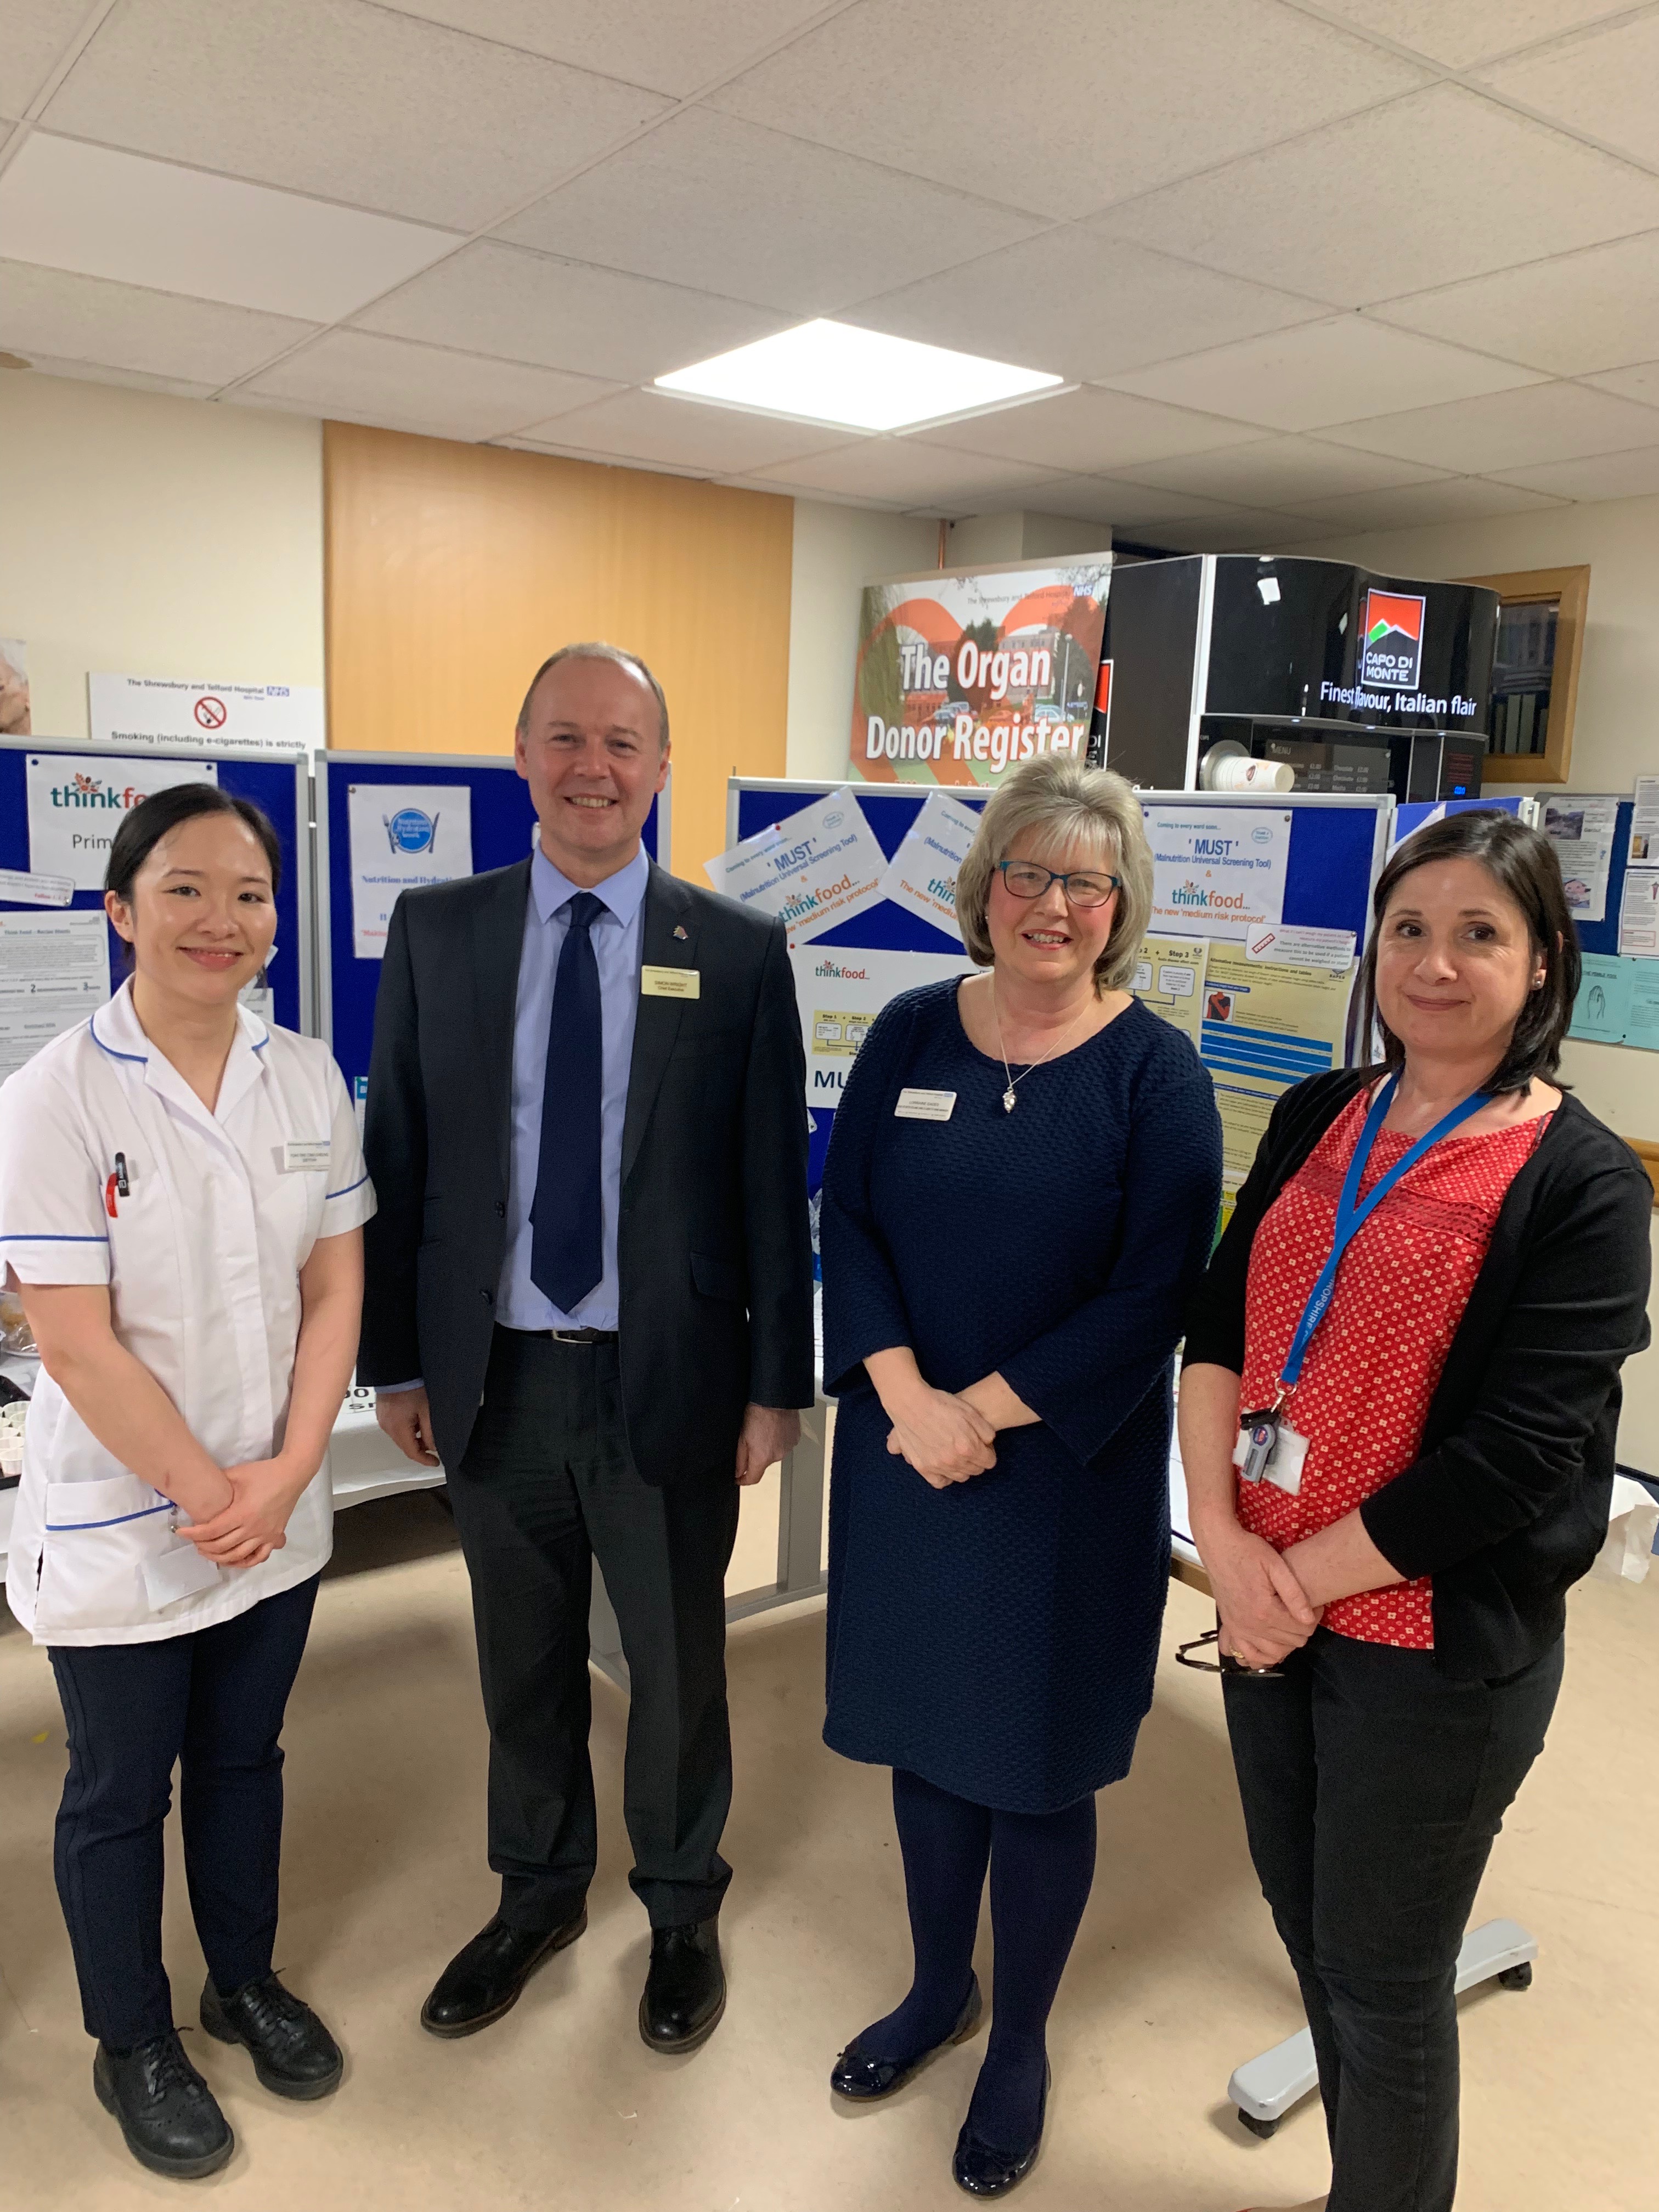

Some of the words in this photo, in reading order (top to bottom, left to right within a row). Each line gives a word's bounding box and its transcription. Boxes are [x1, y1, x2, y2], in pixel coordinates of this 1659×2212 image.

[1074, 585, 1093, 596] NHS
[1366, 651, 1396, 668] CAPO
[1398, 656, 1413, 669] DI
[901, 642, 950, 691] The
[958, 640, 1052, 701] Organ
[1366, 667, 1409, 682] MONTE
[144, 680, 188, 691] Shrewsbury
[234, 686, 264, 694] Hospital
[1321, 681, 1354, 705] Finest
[1354, 686, 1391, 713] flavour,
[1395, 692, 1447, 714] Italian
[1451, 695, 1477, 716] flair
[111, 731, 154, 743] Smoking
[157, 733, 204, 746] (including
[206, 736, 263, 748] e-cigarettes)
[276, 741, 306, 750] strictly
[866, 715, 948, 761] Donor
[953, 714, 1085, 774] Register
[50, 785, 148, 809] thinkfo
[72, 834, 112, 849] Prim
[924, 836, 962, 864] (Malnutrition
[1194, 839, 1233, 855] MUST
[774, 840, 812, 871] MUST
[1155, 853, 1190, 863] (Malnutrition
[1192, 855, 1221, 865] Universal
[1223, 857, 1254, 869] Screening
[1256, 859, 1271, 870] Tool)
[740, 877, 780, 902] (Malnutrition
[779, 860, 809, 879] Universal
[809, 844, 842, 864] Screening
[840, 833, 857, 847] Tool)
[831, 898, 846, 910] risk
[900, 879, 913, 893] The
[914, 890, 930, 903] new
[933, 899, 957, 919] 'mediu
[1215, 912, 1229, 921] risk
[1169, 950, 1183, 958] Step
[815, 1070, 847, 1089] MU
[1306, 1276, 1334, 1329] ROPSHIRE
